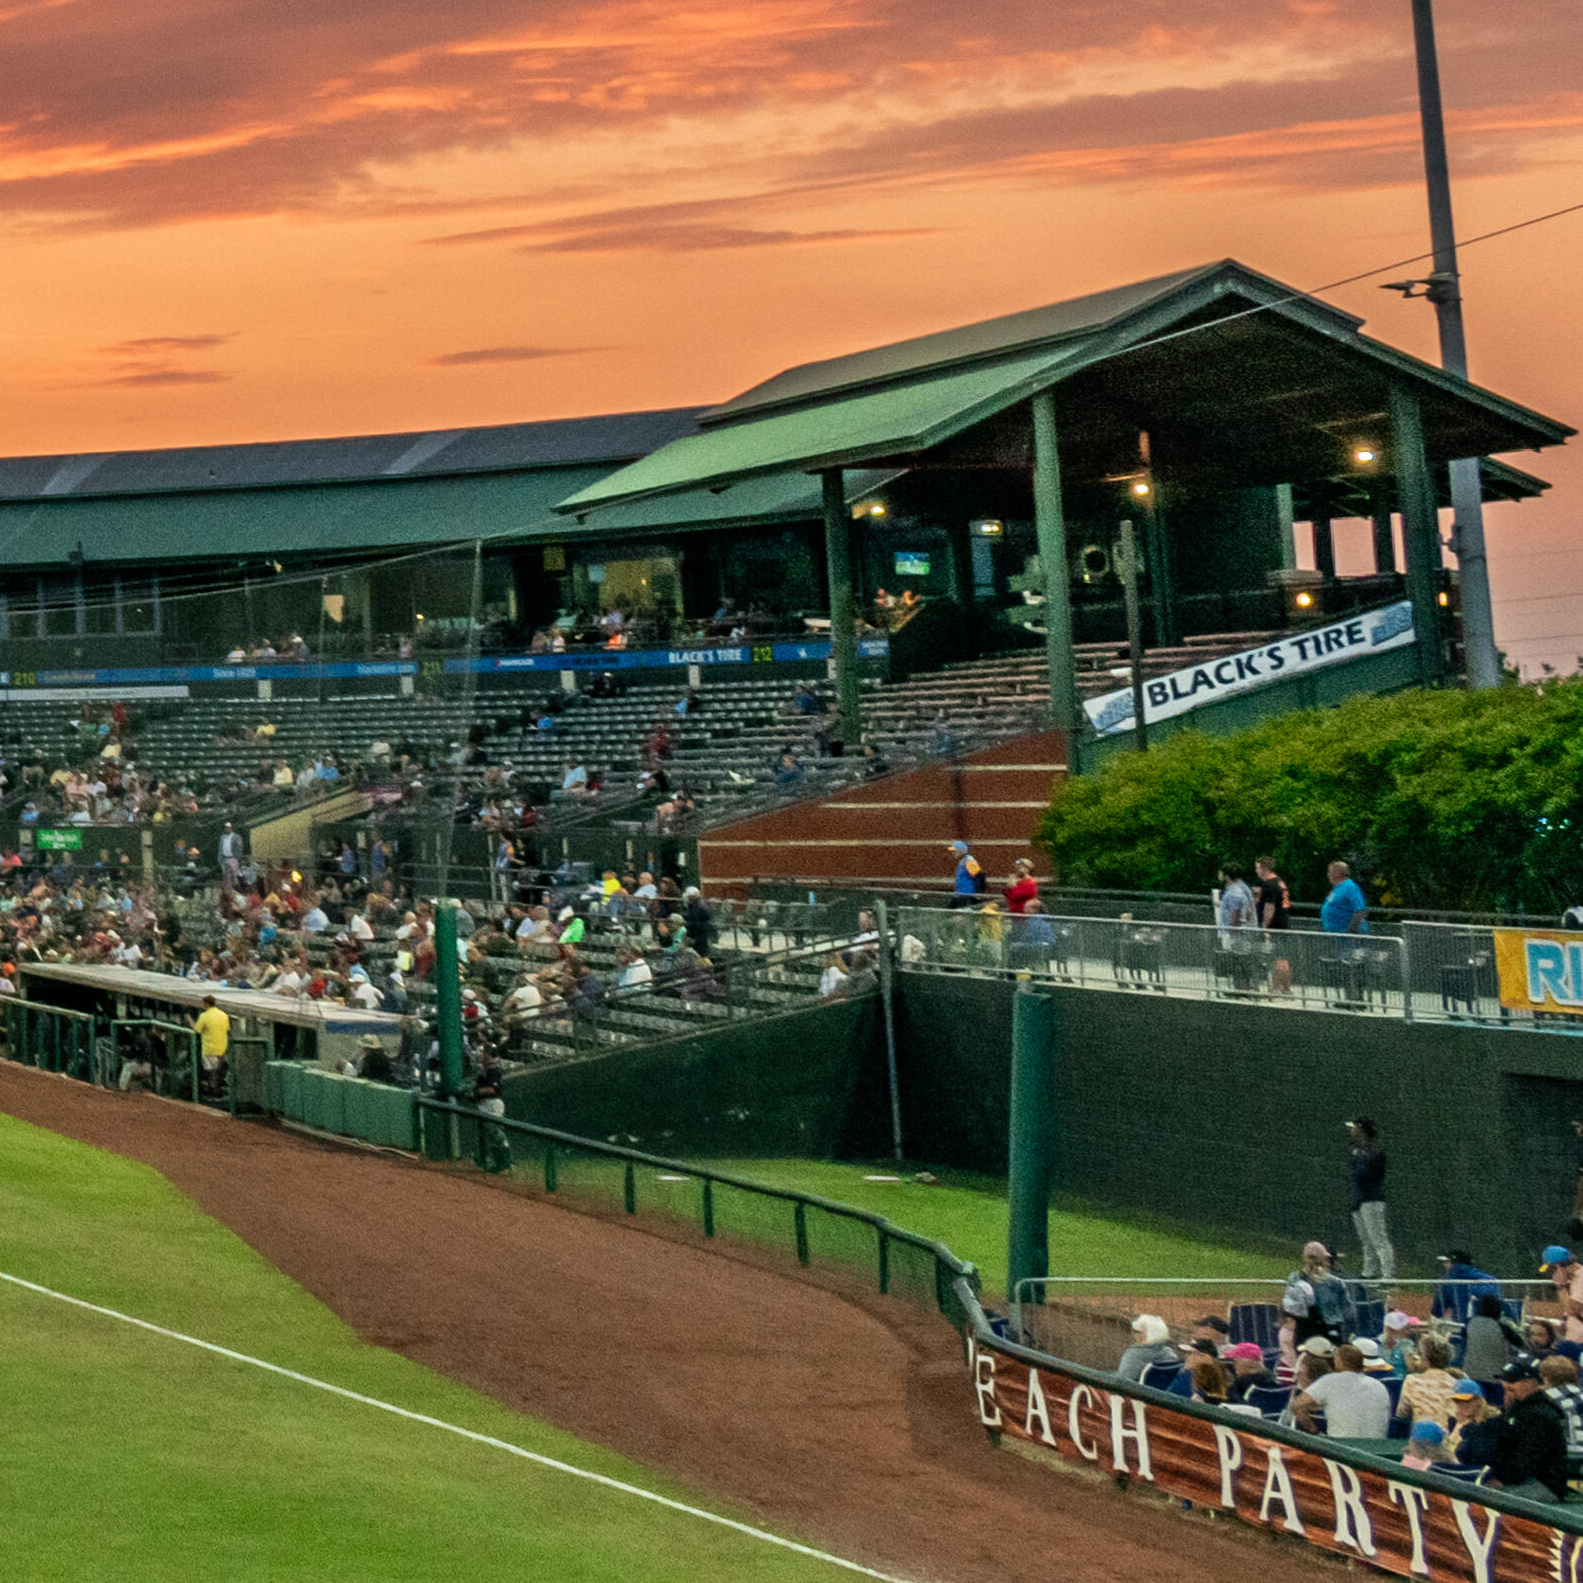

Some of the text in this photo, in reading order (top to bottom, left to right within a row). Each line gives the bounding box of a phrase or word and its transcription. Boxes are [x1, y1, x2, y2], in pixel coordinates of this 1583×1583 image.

[12, 671, 36, 686] 210
[668, 648, 742, 664] BLACK'S TIRE
[1147, 645, 1285, 708] BLACK'S
[1290, 620, 1367, 661] TIRE
[967, 1336, 1503, 1583] EACH PARTY
